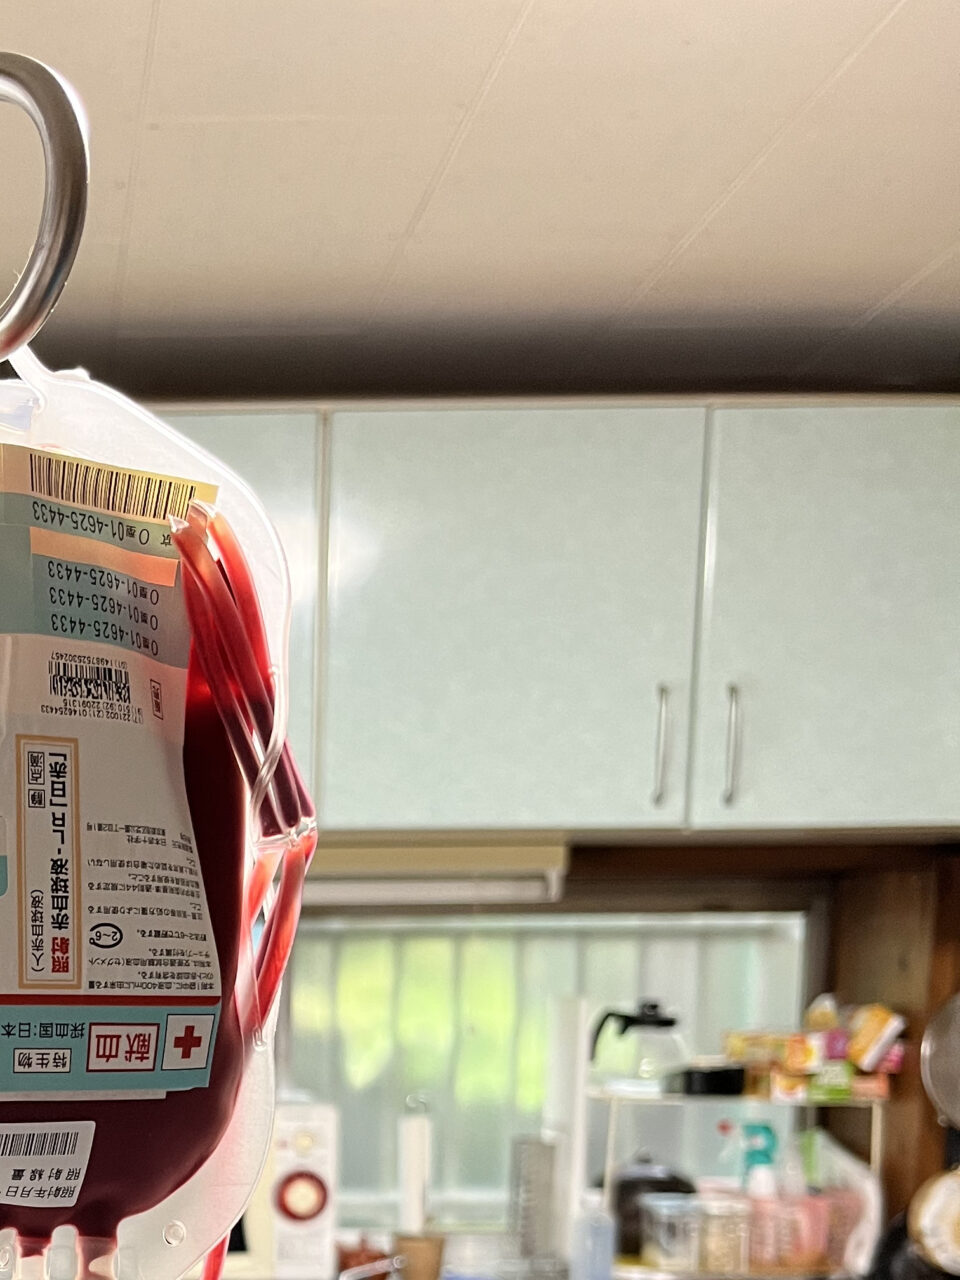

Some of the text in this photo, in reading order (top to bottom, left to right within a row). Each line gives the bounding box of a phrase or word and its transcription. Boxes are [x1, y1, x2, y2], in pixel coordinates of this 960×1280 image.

[50, 936, 70, 973] 照射
[95, 1033, 151, 1063] 献血
[17, 1052, 68, 1069] 特生物
[5, 1186, 77, 1198] 照射年月日
